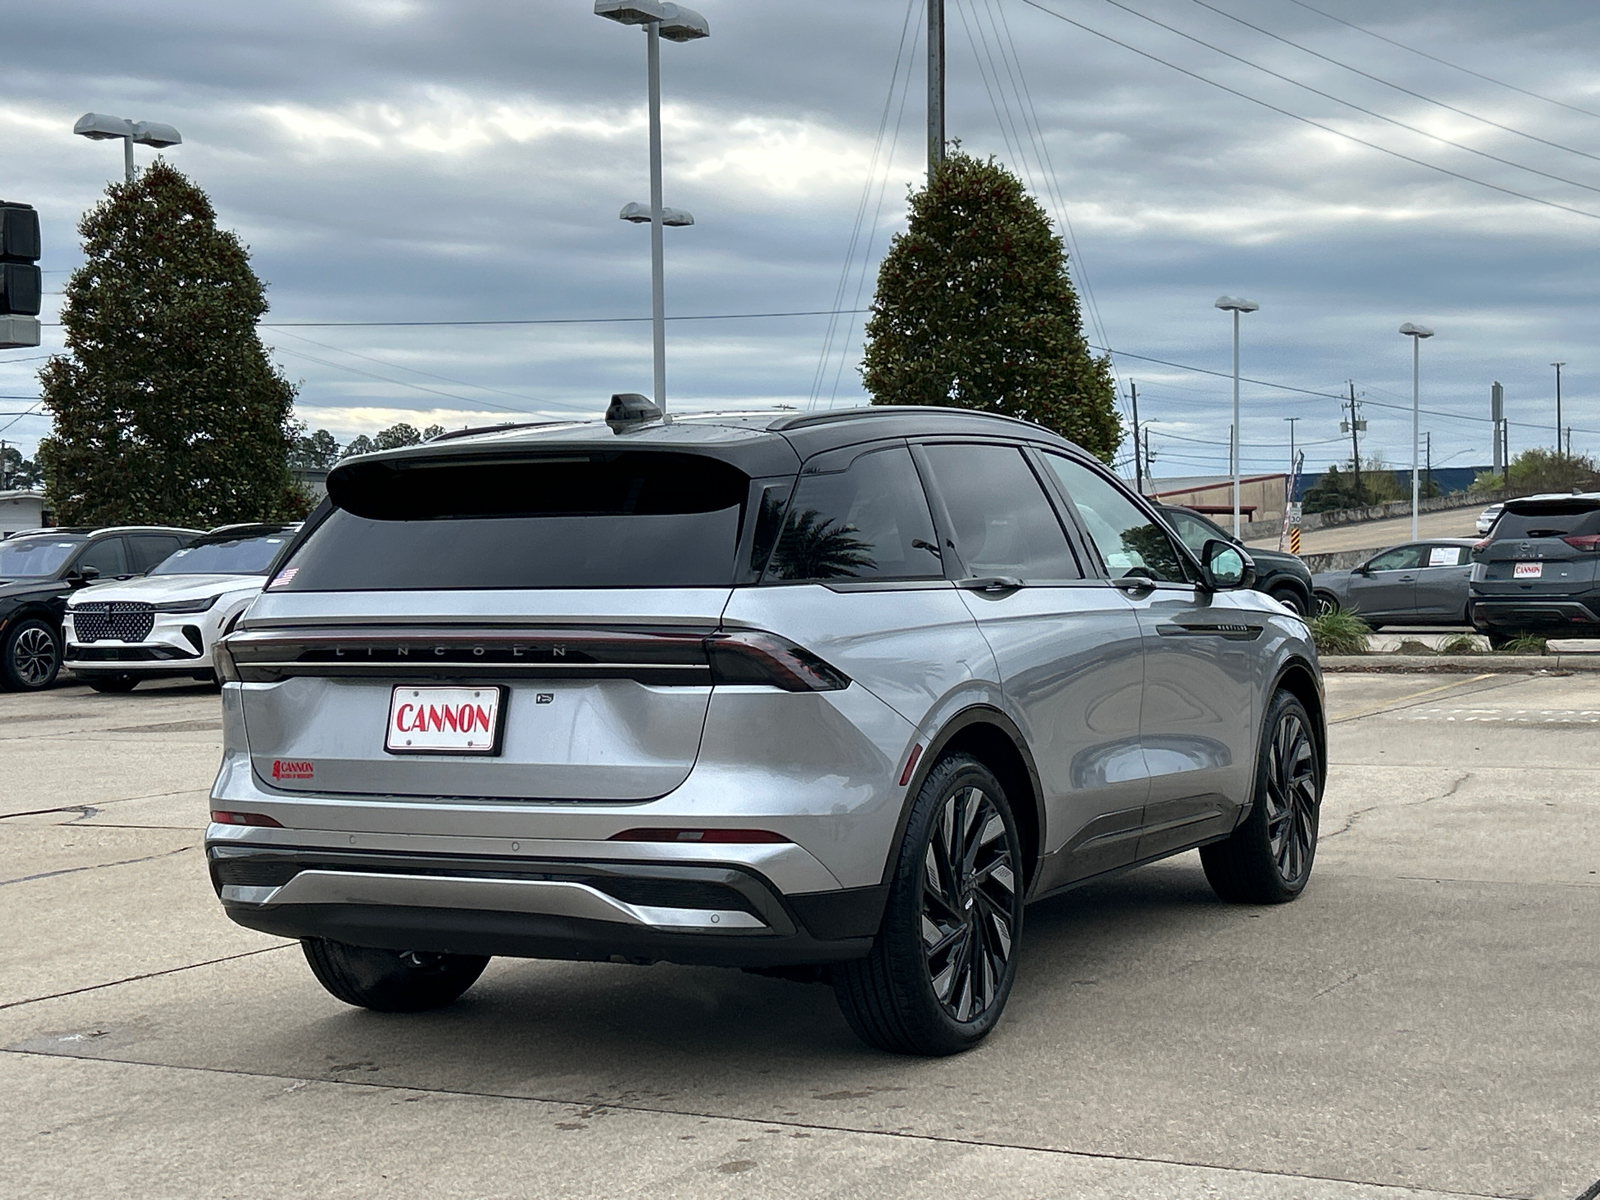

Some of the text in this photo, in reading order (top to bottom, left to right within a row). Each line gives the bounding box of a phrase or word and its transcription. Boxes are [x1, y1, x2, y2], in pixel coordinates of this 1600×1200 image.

[1516, 566, 1540, 574] CANNON
[336, 647, 565, 657] LINCOLN
[397, 704, 492, 733] CANNON
[281, 761, 313, 772] CANNON
